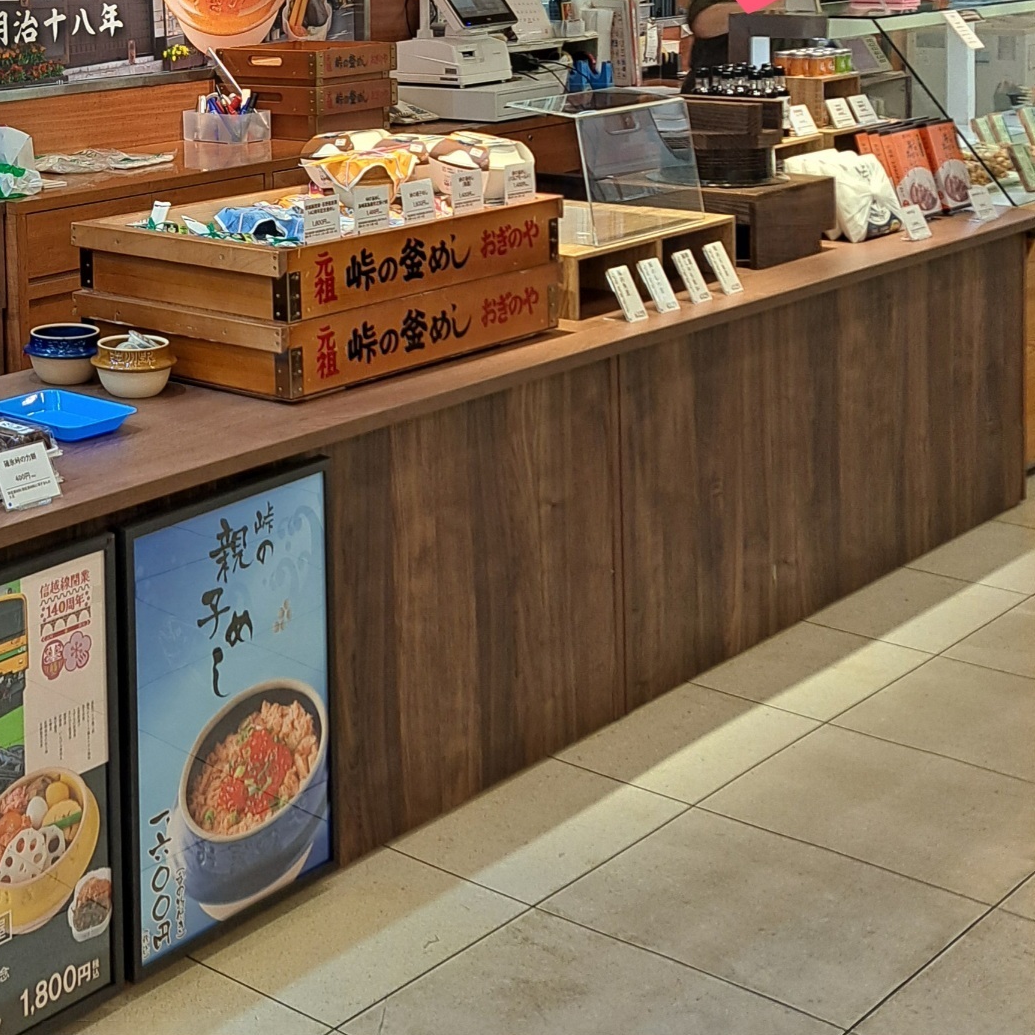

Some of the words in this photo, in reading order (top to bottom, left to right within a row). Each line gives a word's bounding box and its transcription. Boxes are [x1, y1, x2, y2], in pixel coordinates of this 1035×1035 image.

[314, 251, 339, 305] 元祖
[346, 234, 472, 292] 峠の釜めし
[480, 219, 540, 259] おぎのや
[316, 325, 340, 380] 元祖
[347, 303, 473, 364] 峠の釜めし
[480, 286, 540, 328] おぎのや
[45, 594, 86, 619] 140周年
[19, 960, 92, 1018] 1,800円
